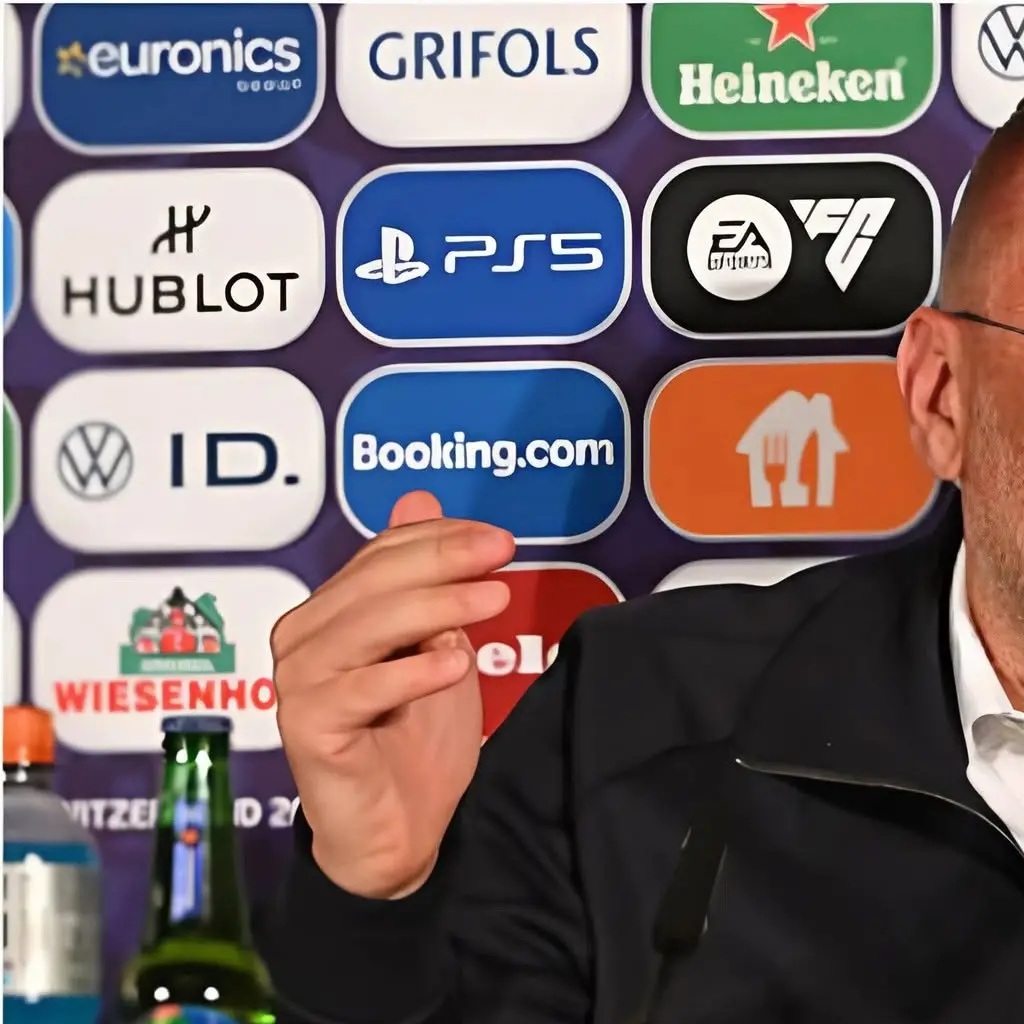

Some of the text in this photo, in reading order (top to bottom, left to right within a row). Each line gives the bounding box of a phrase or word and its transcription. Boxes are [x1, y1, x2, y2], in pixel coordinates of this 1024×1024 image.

[87, 28, 301, 78] euronics
[369, 27, 600, 81] GRIFOLS
[678, 60, 905, 105] Heineken
[444, 232, 603, 274] PS5
[63, 272, 299, 317] HUBLOT
[171, 433, 300, 487] ID.
[353, 431, 615, 478] Booking.com
